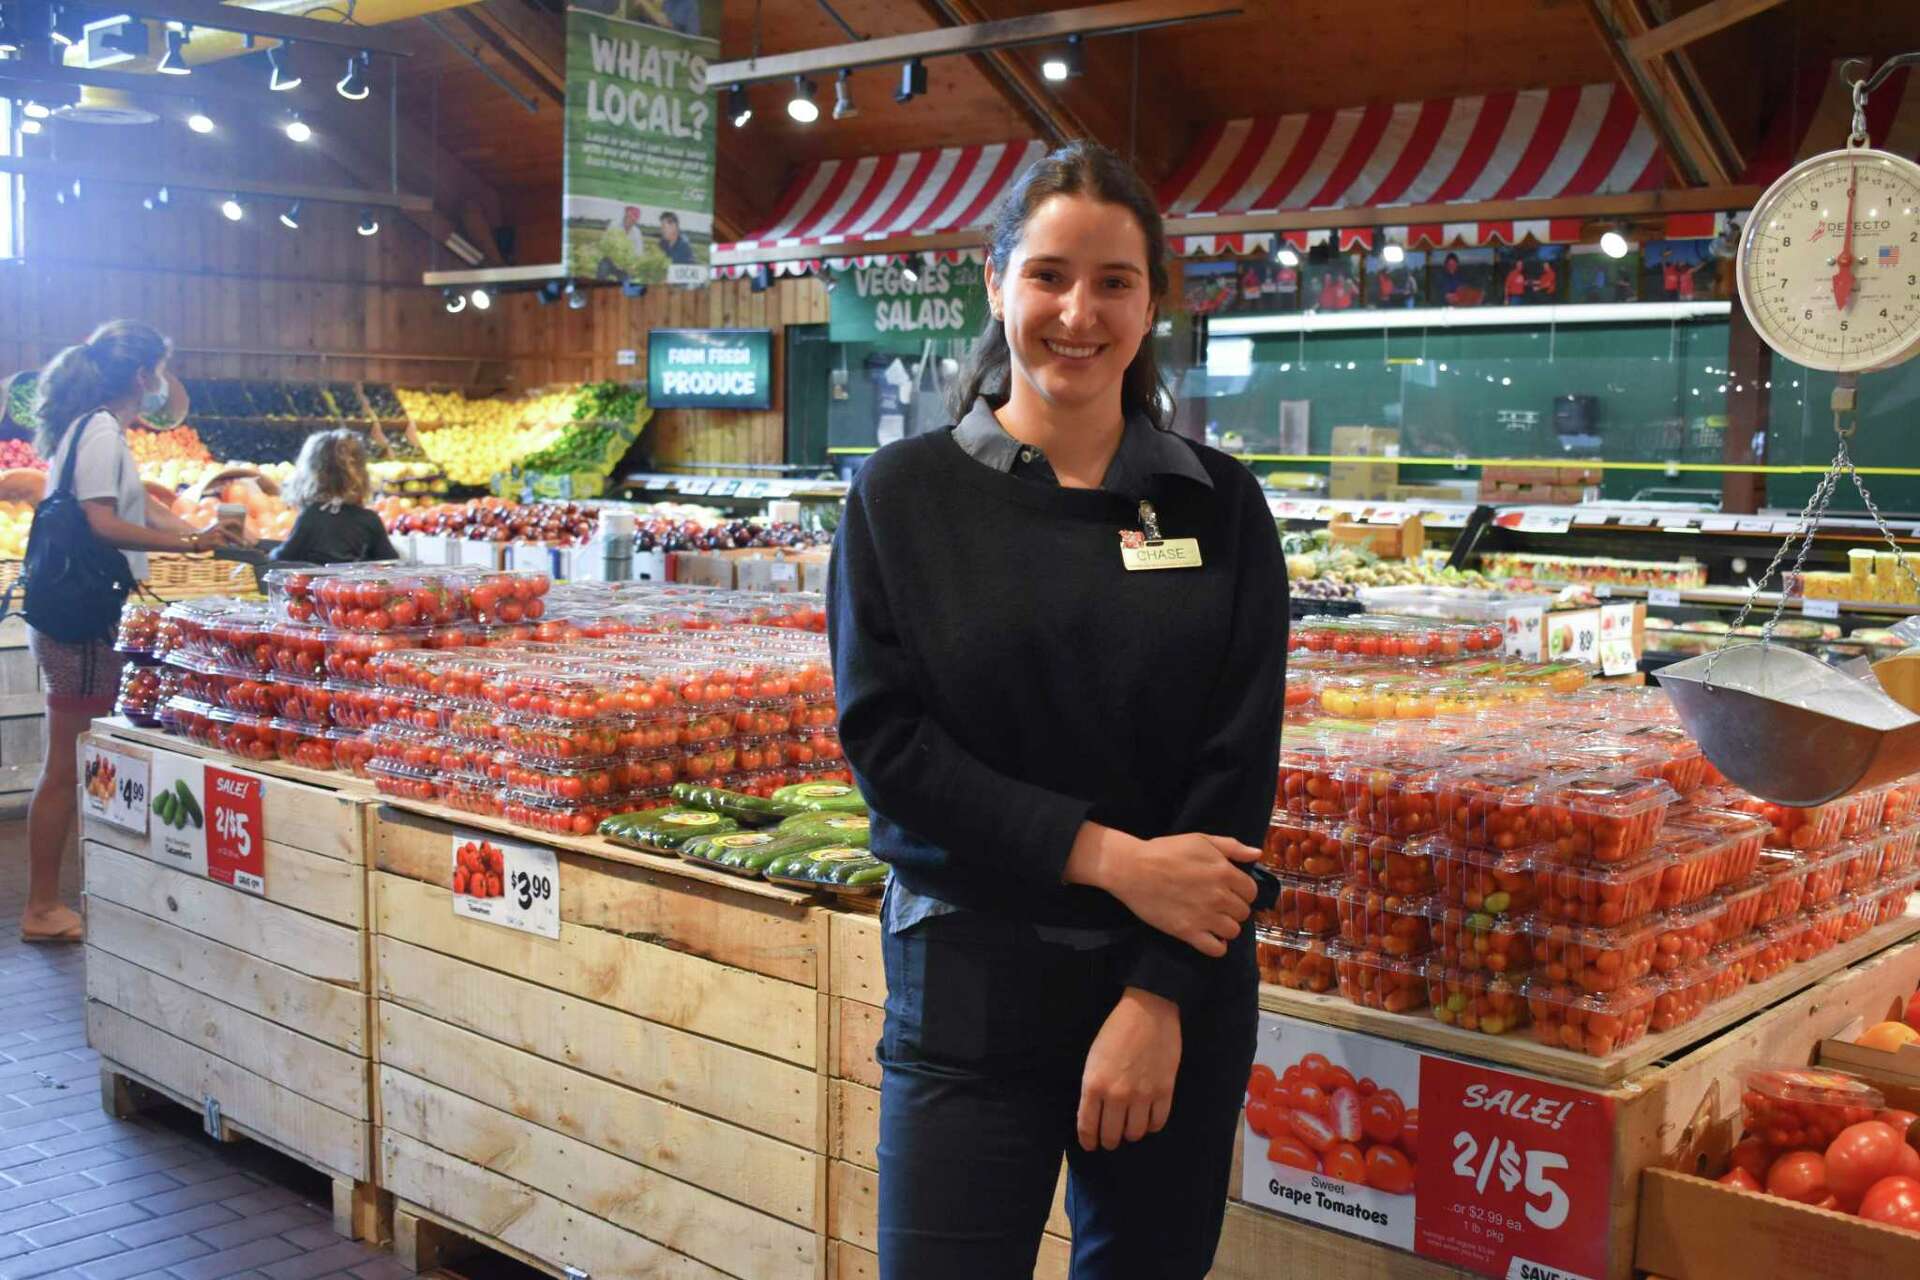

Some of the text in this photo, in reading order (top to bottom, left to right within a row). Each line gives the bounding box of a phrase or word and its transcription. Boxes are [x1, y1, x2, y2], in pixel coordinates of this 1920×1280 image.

[589, 33, 708, 94] WHAT'S
[587, 79, 709, 141] LOCAL?
[1810, 200, 1818, 211] 9
[1827, 220, 1891, 232] DEECTO
[1783, 237, 1791, 248] 8
[1910, 231, 1918, 243] 2
[1781, 278, 1788, 289] 7
[1908, 275, 1916, 286] 3
[875, 298, 964, 331] SALADS
[1805, 309, 1813, 320] 6
[1879, 308, 1887, 318] 4
[1840, 321, 1848, 332] 5
[668, 347, 750, 365] FARM FRESH
[662, 370, 756, 396] PRODUCE
[1137, 548, 1186, 561] CHASE
[216, 777, 248, 799] SALE!
[1462, 1084, 1575, 1130] SALE!
[1311, 1175, 1345, 1195] Sweet
[1452, 1131, 1570, 1230] 2/$5
[1269, 1179, 1389, 1226] Grape Tomatoes
